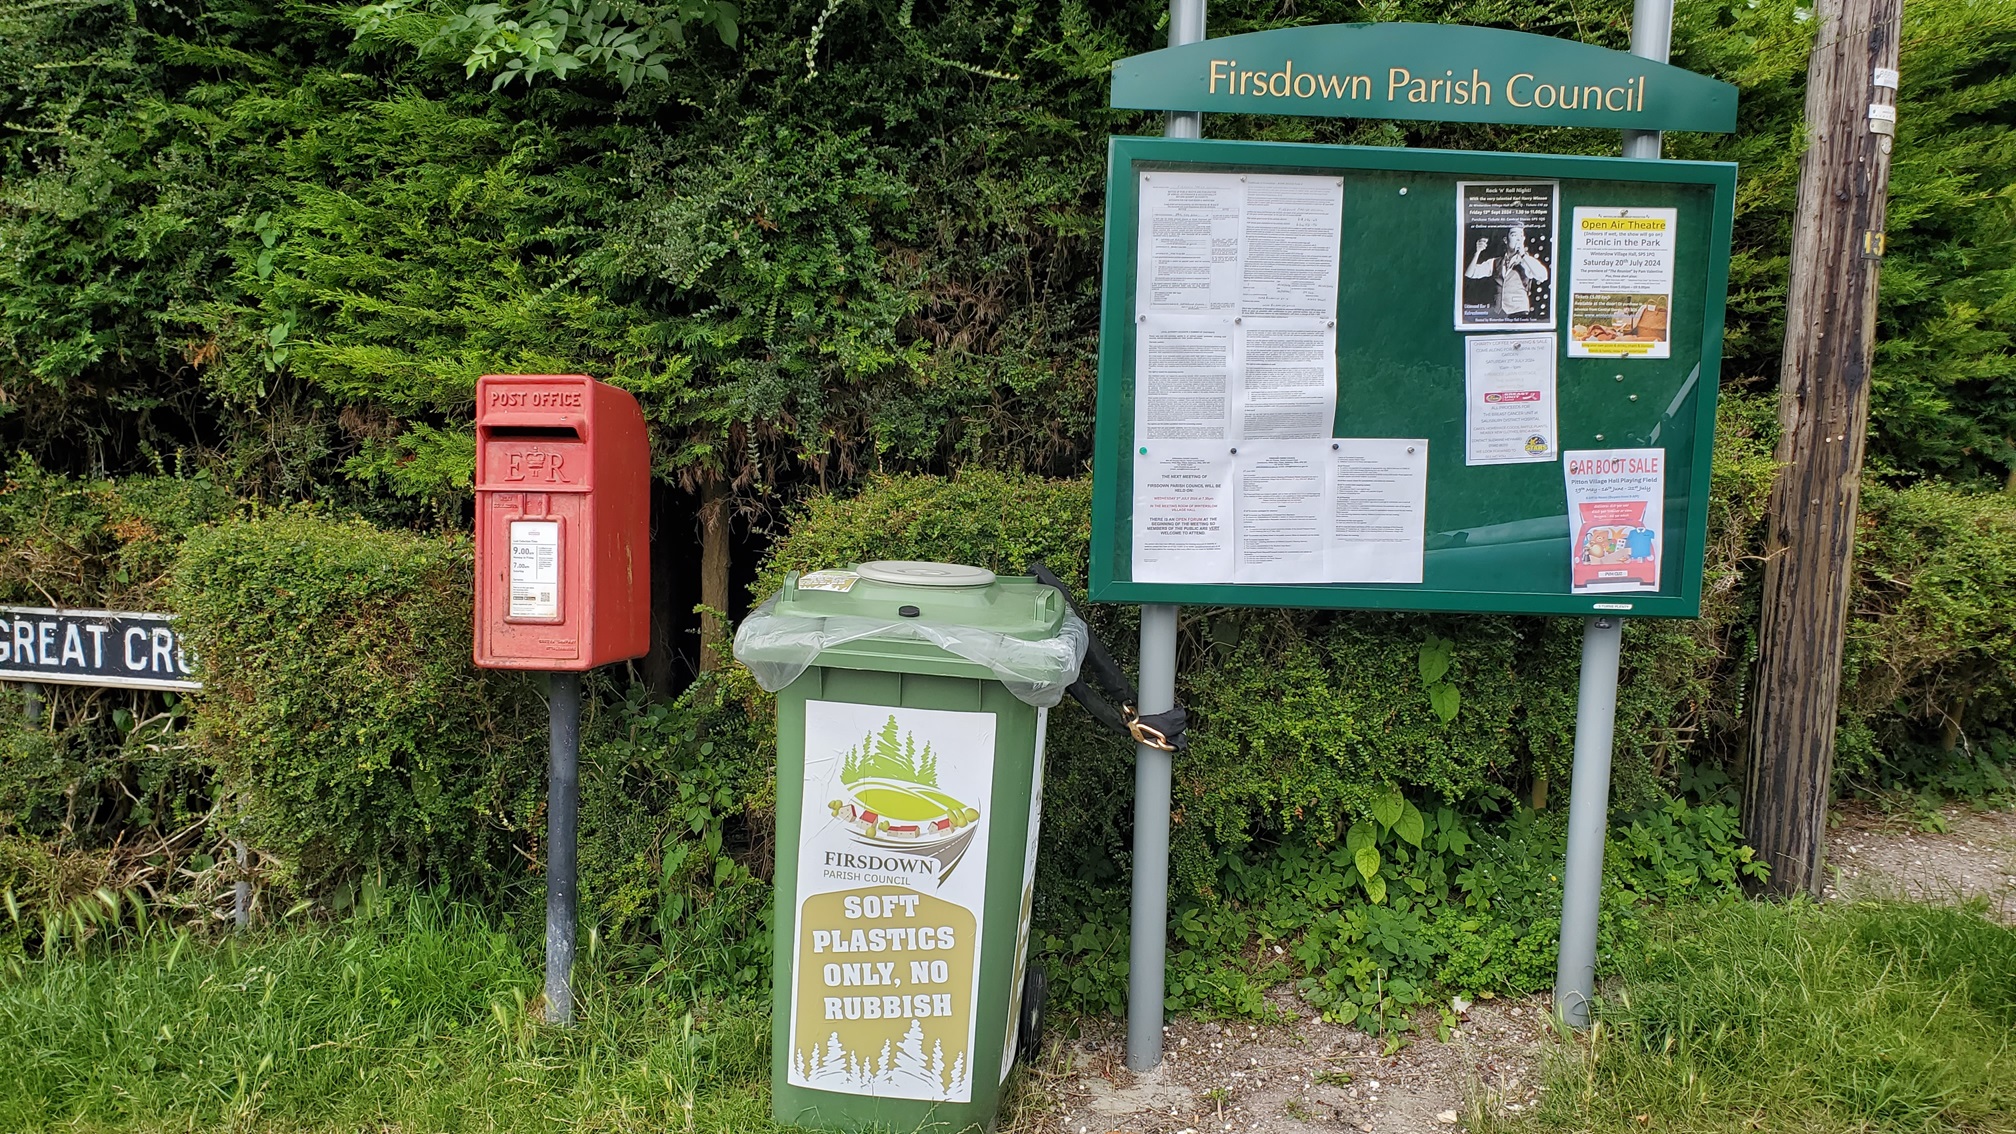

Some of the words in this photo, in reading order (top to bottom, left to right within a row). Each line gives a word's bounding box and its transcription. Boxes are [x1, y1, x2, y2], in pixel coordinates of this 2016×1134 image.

[1208, 60, 1372, 100] Firsdown
[1387, 68, 1491, 106] Parish
[1505, 73, 1646, 112] Council
[1581, 220, 1607, 230] Open
[1610, 220, 1625, 229] Air
[1628, 221, 1666, 230] Theatre
[1864, 231, 1885, 256] 13
[491, 391, 527, 407] POST
[532, 392, 581, 407] OFFICE
[1570, 459, 1593, 475] CAR
[1596, 458, 1626, 474] BOOT
[1629, 458, 1658, 473] SALE
[824, 851, 933, 874] FIRSDOWN
[823, 869, 861, 882] PARISH
[864, 873, 911, 886] COUNCIL
[843, 894, 920, 919] SOFT
[812, 926, 955, 954] PLASTICS
[823, 962, 901, 988] ONLY,
[909, 960, 949, 984] NO
[824, 993, 952, 1020] RUBBISH
